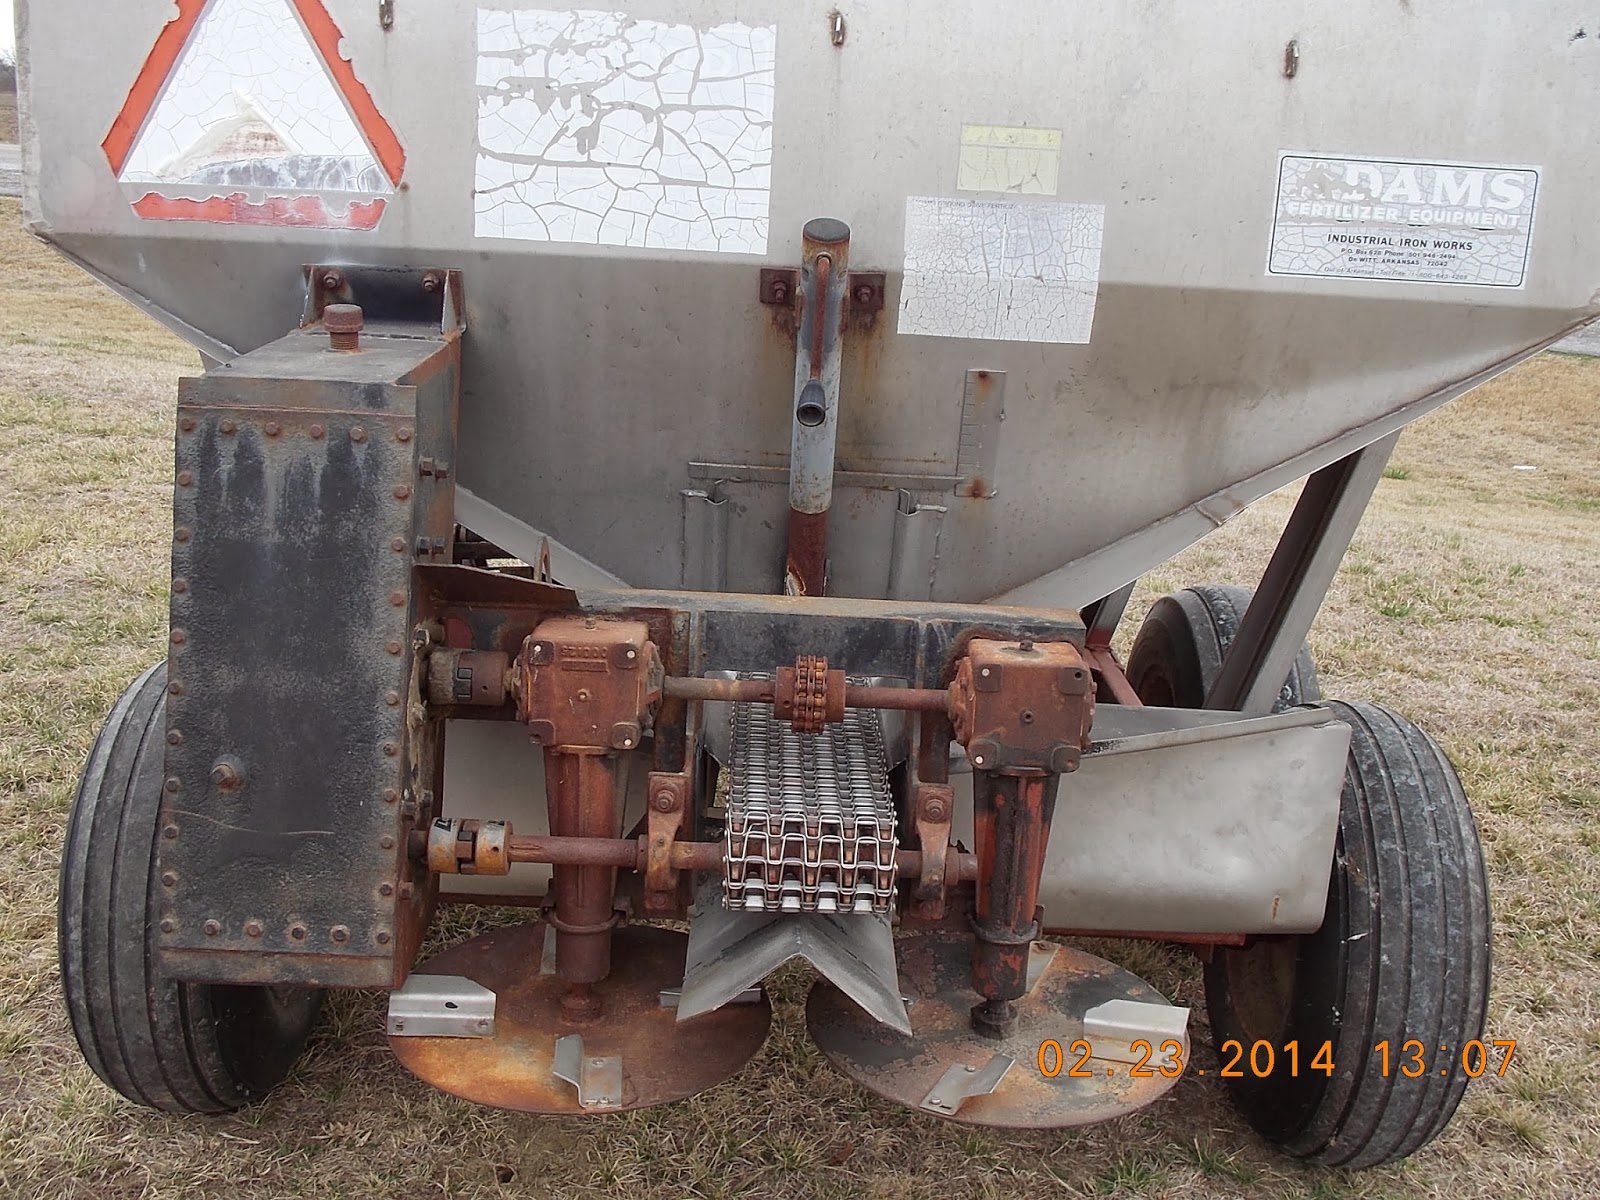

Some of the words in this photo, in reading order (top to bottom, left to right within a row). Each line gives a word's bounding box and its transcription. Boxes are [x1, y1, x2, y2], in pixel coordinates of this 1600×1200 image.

[1290, 160, 1526, 210] DAMS
[1287, 201, 1402, 222] FERTILIZER
[1408, 208, 1521, 227] EQUIPMENT
[1328, 234, 1394, 247] INDUSTRIAL
[1399, 238, 1428, 249] IRON
[1433, 240, 1473, 251] WORKS
[1384, 249, 1404, 257] Phone
